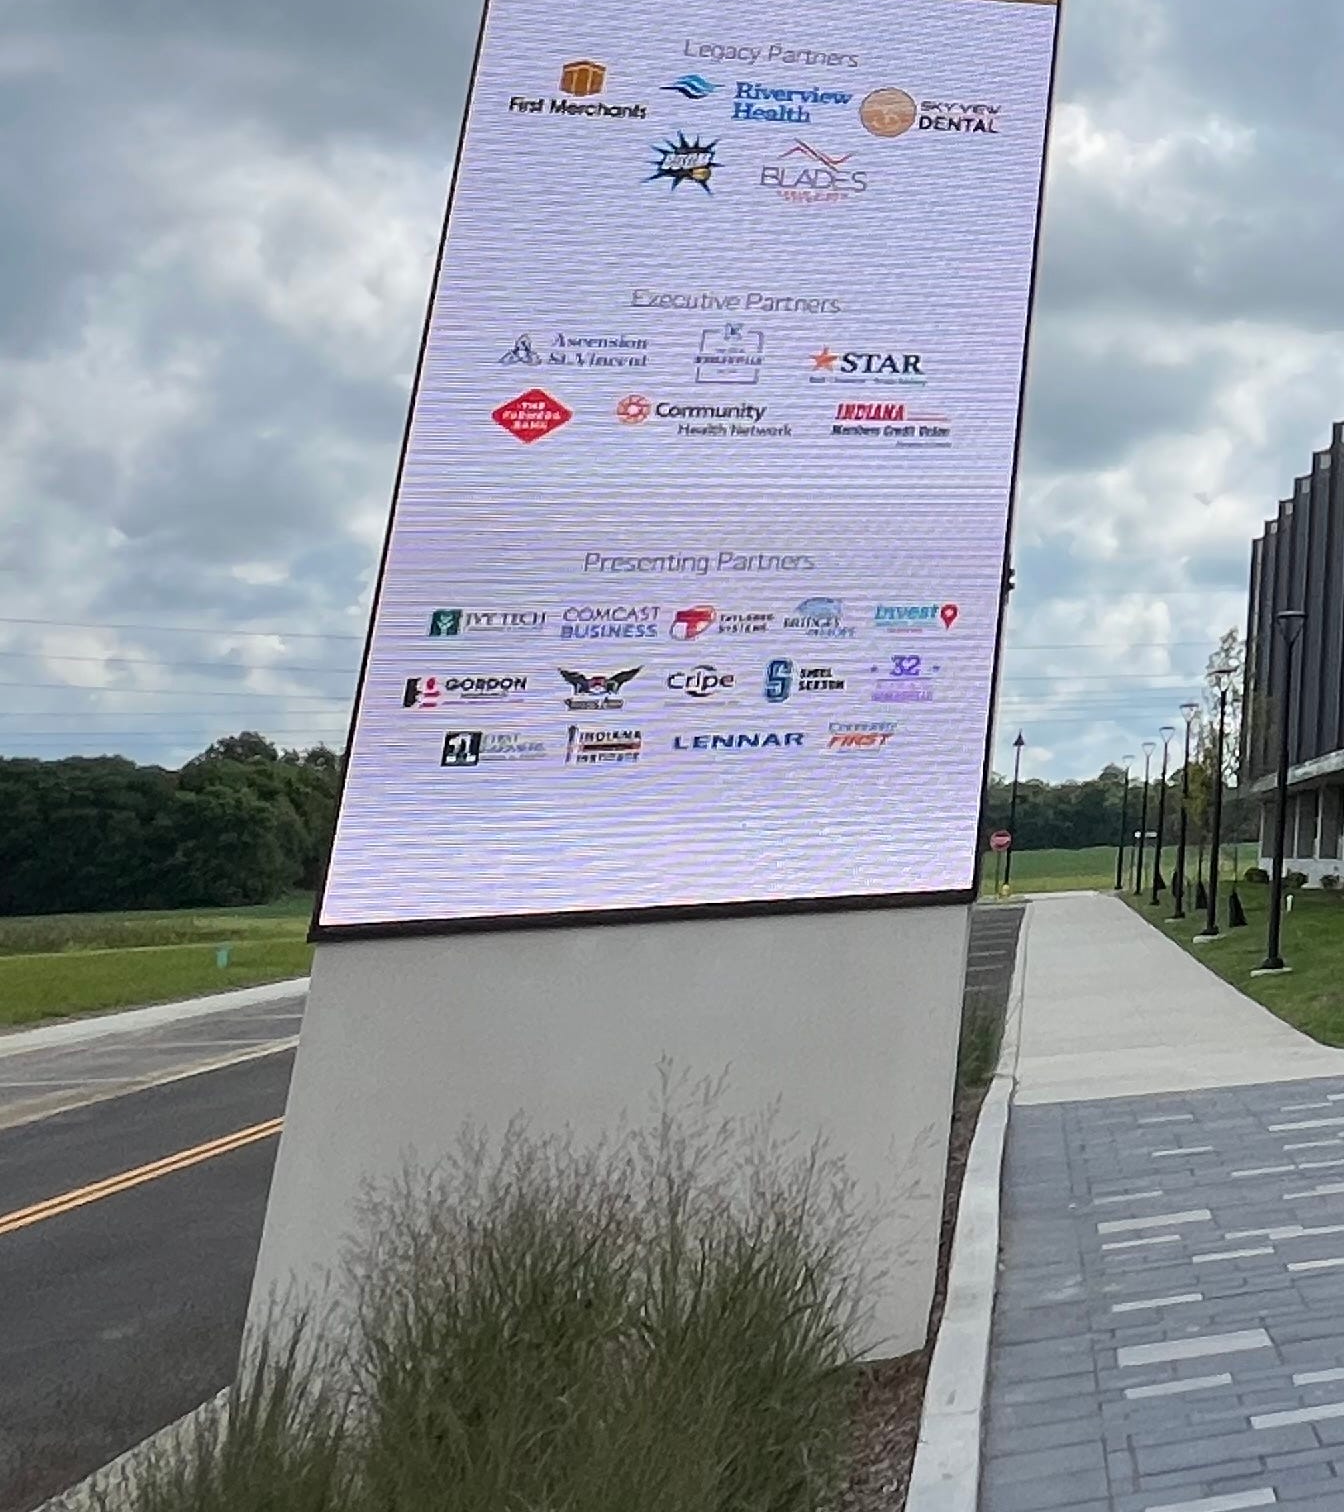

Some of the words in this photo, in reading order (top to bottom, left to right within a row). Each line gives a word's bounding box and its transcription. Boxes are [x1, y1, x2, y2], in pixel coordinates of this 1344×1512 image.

[683, 39, 761, 65] Legacy
[769, 44, 859, 68] Partners
[735, 81, 853, 105] Riverview
[508, 97, 545, 113] First
[550, 98, 647, 120] Merchants
[731, 101, 811, 124] Health
[921, 100, 1001, 115] SKYVIEW
[918, 115, 1000, 134] DENTAL
[760, 165, 868, 193] BLADES
[631, 289, 740, 311] Executive
[746, 292, 843, 314] Partners
[552, 333, 648, 350] Ascension
[574, 352, 648, 367] Vincent
[841, 352, 925, 375] STAR
[656, 402, 767, 421] Community
[835, 403, 904, 420] INDIANA
[678, 423, 727, 437] Health
[731, 425, 792, 438] Network
[583, 551, 709, 575] Presenting
[717, 551, 815, 572] Partners
[562, 606, 661, 622] COMCAST
[560, 624, 658, 639] BUSINESS
[889, 654, 921, 676] 32
[445, 676, 527, 691] GORDON
[673, 732, 805, 750] LENNAR
